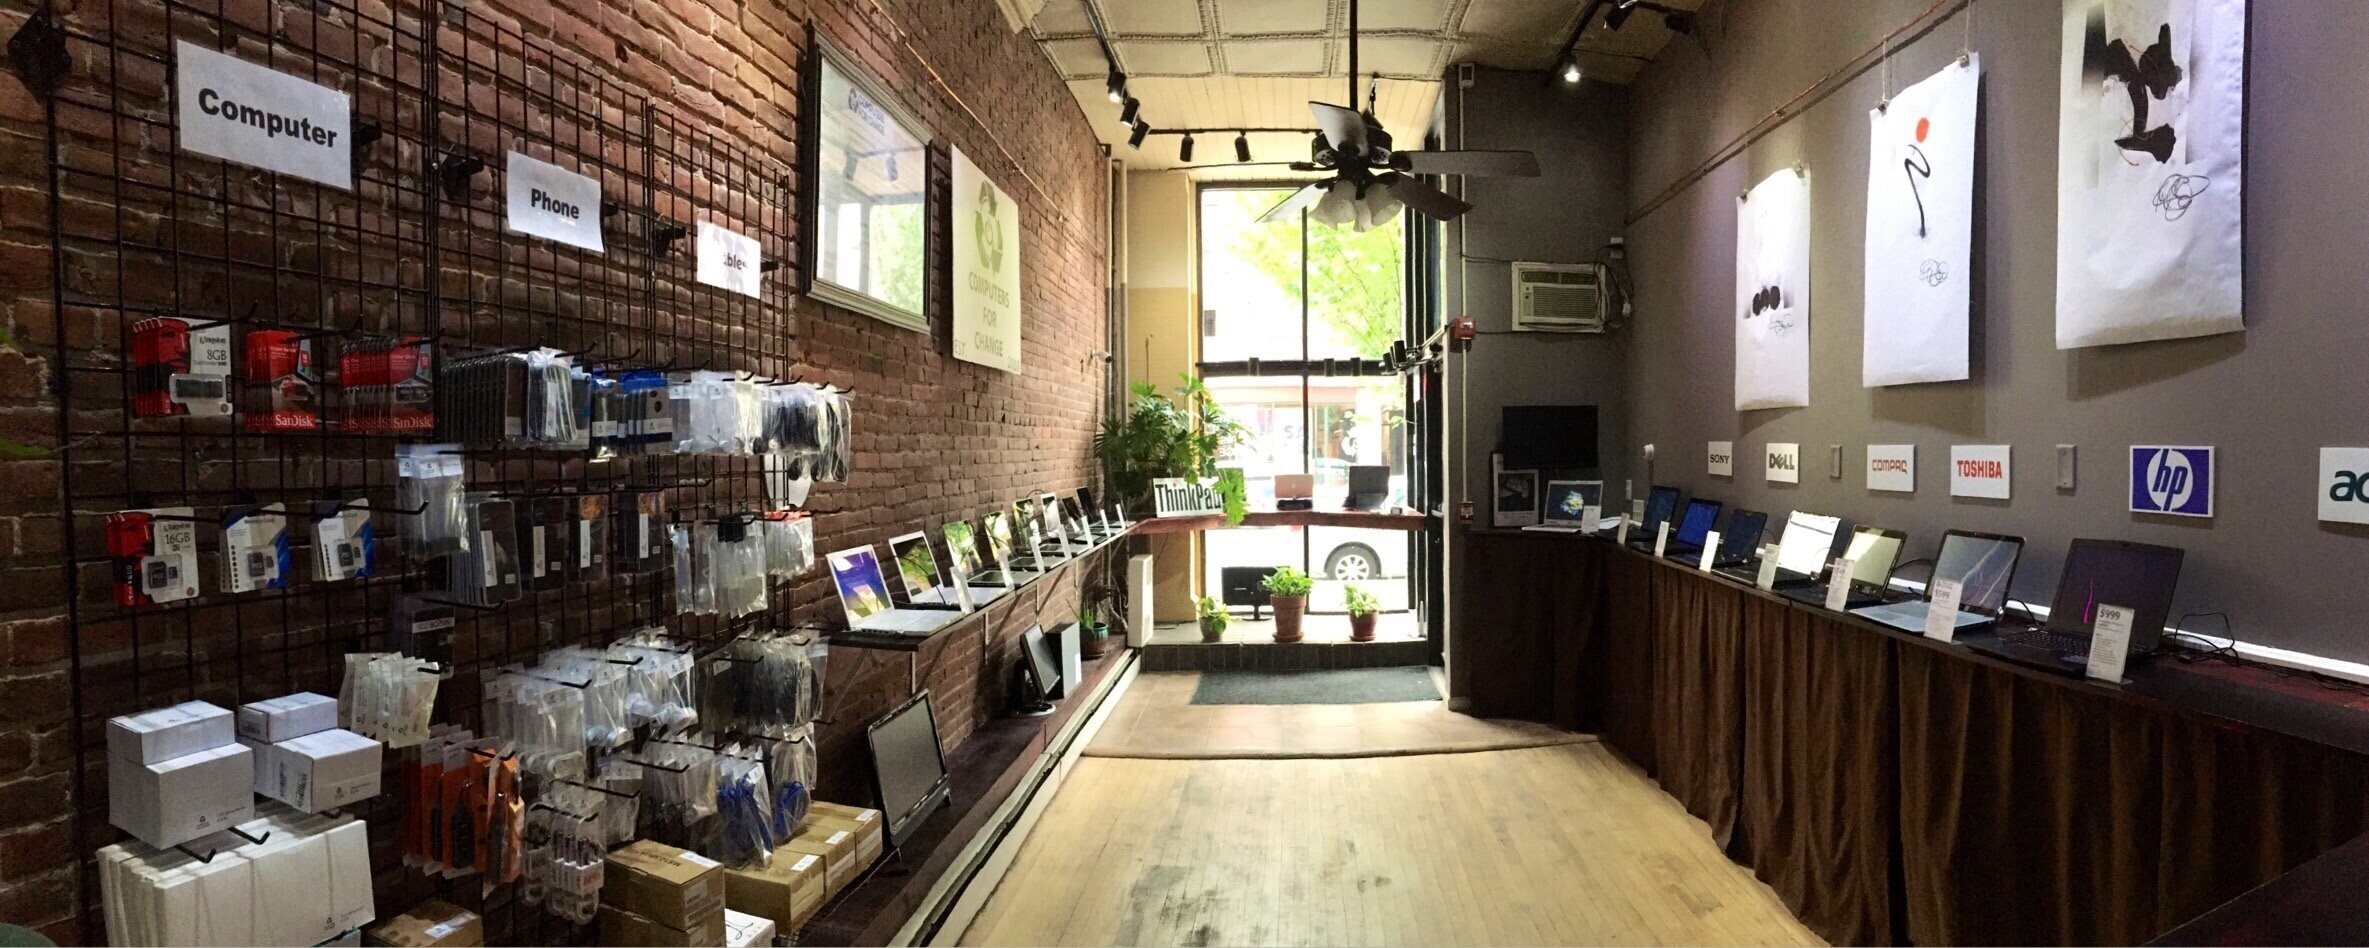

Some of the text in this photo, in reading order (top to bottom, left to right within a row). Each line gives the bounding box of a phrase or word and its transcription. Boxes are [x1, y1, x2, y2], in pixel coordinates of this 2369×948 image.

[198, 88, 337, 148] Computer
[530, 188, 579, 219] Phone
[723, 252, 748, 271] ble
[968, 271, 1010, 308] COMPUTERS
[983, 306, 997, 328] FOR
[974, 331, 1003, 357] CHANGE
[207, 349, 227, 361] 8GB
[275, 414, 314, 428] SanDisk
[393, 416, 433, 429] SanDisk
[1709, 453, 1730, 465] SONY
[1768, 452, 1795, 471] DELL
[1872, 459, 1908, 475] COMPAQ
[1956, 459, 2003, 479] TOSHIBA
[2152, 448, 2189, 512] hp
[164, 532, 191, 545] 16GB
[2100, 608, 2121, 621] $999
